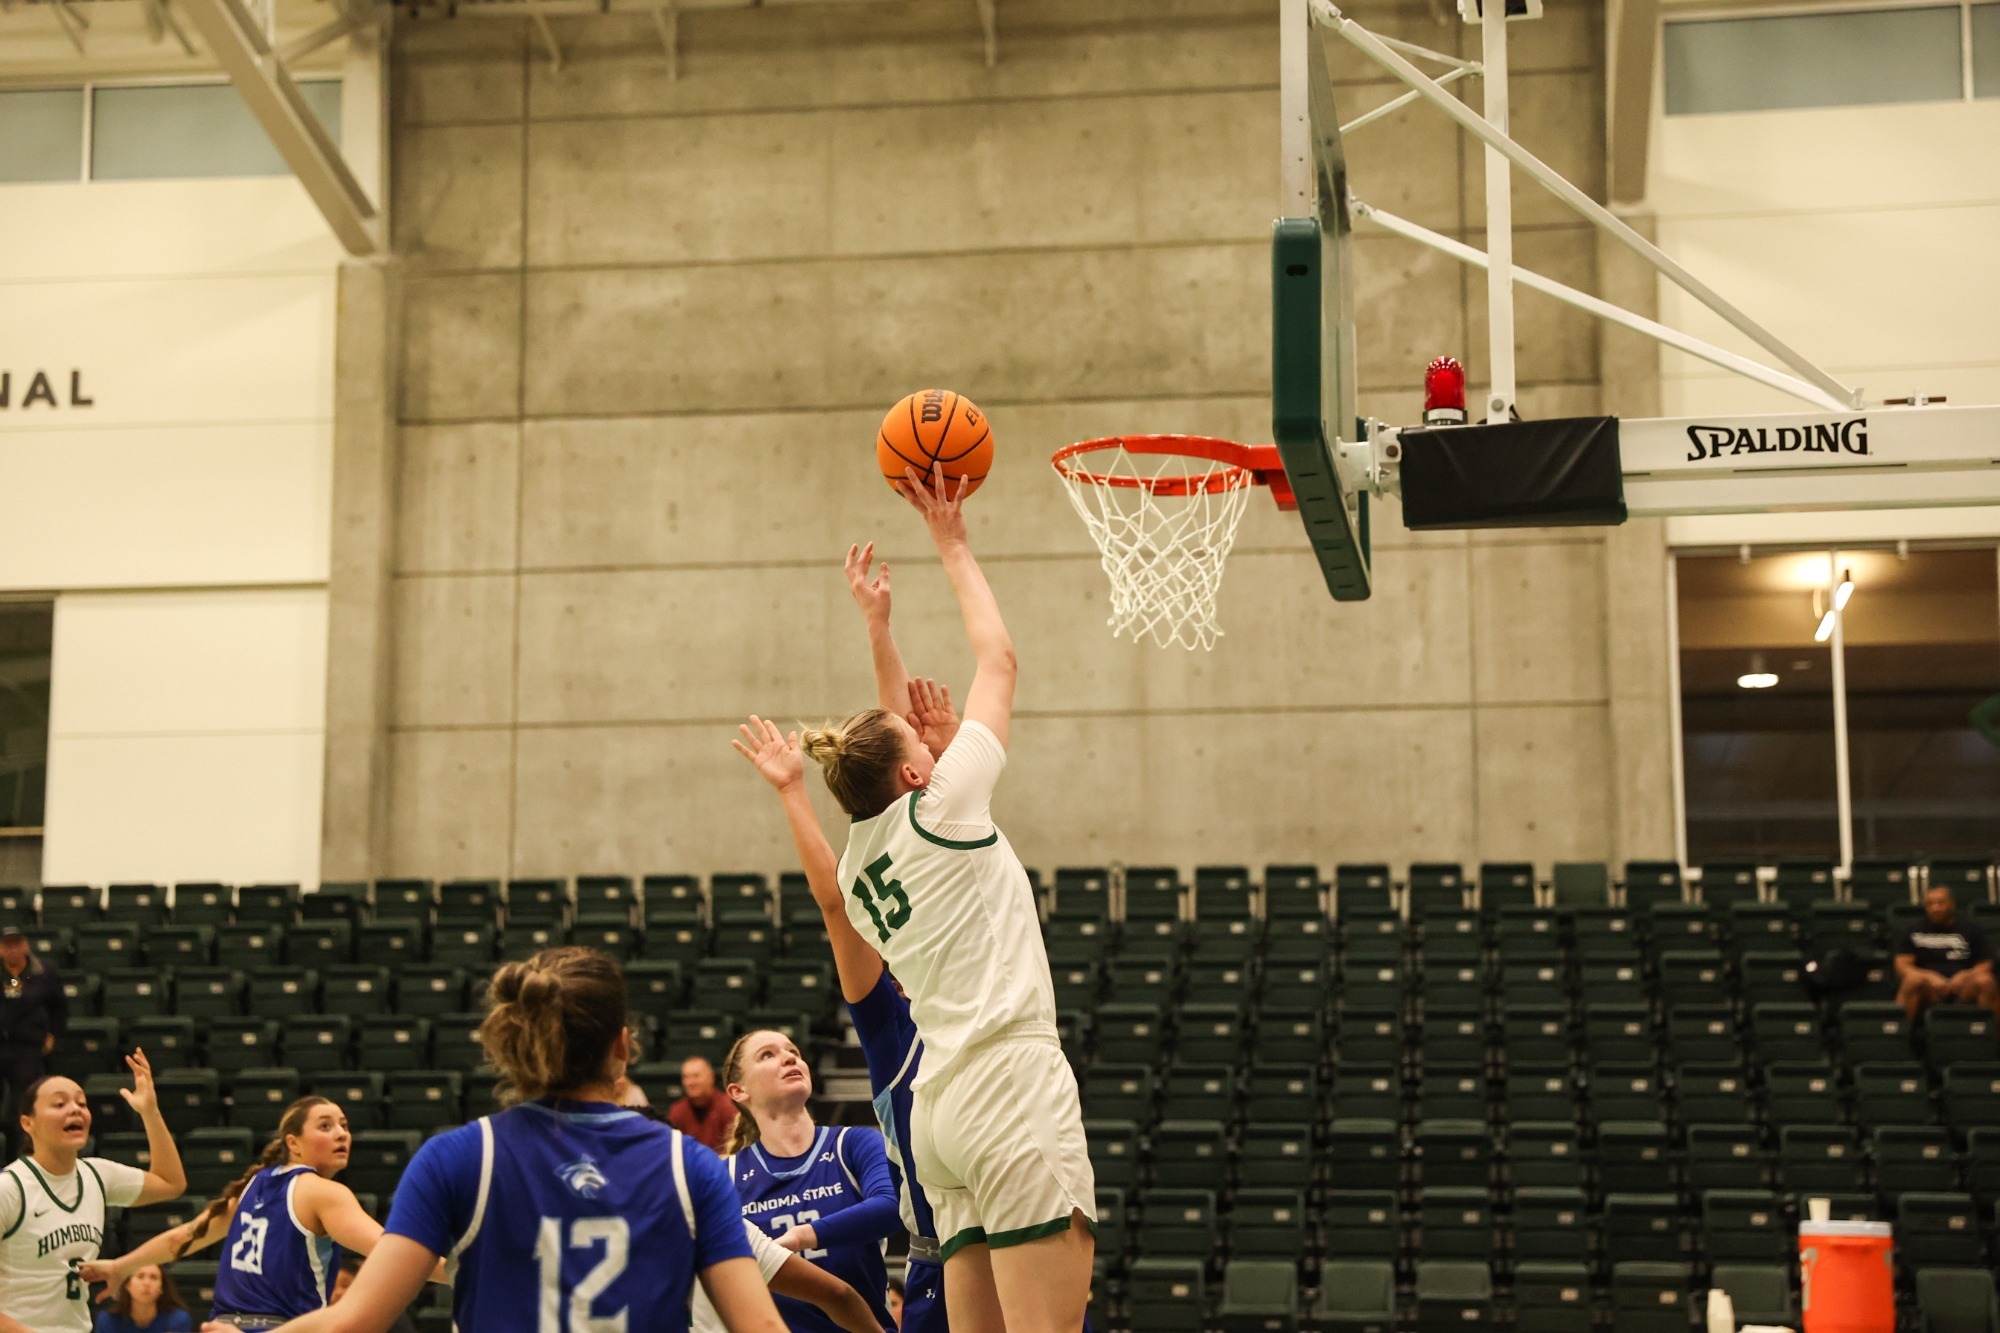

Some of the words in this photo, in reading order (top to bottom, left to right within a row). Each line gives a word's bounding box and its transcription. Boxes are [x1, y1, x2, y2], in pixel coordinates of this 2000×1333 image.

[1686, 417, 1869, 462] SPALDING
[851, 851, 912, 944] 15
[741, 1194, 801, 1216] SONOMA
[802, 1182, 844, 1201] STATE
[532, 1216, 630, 1333] 12
